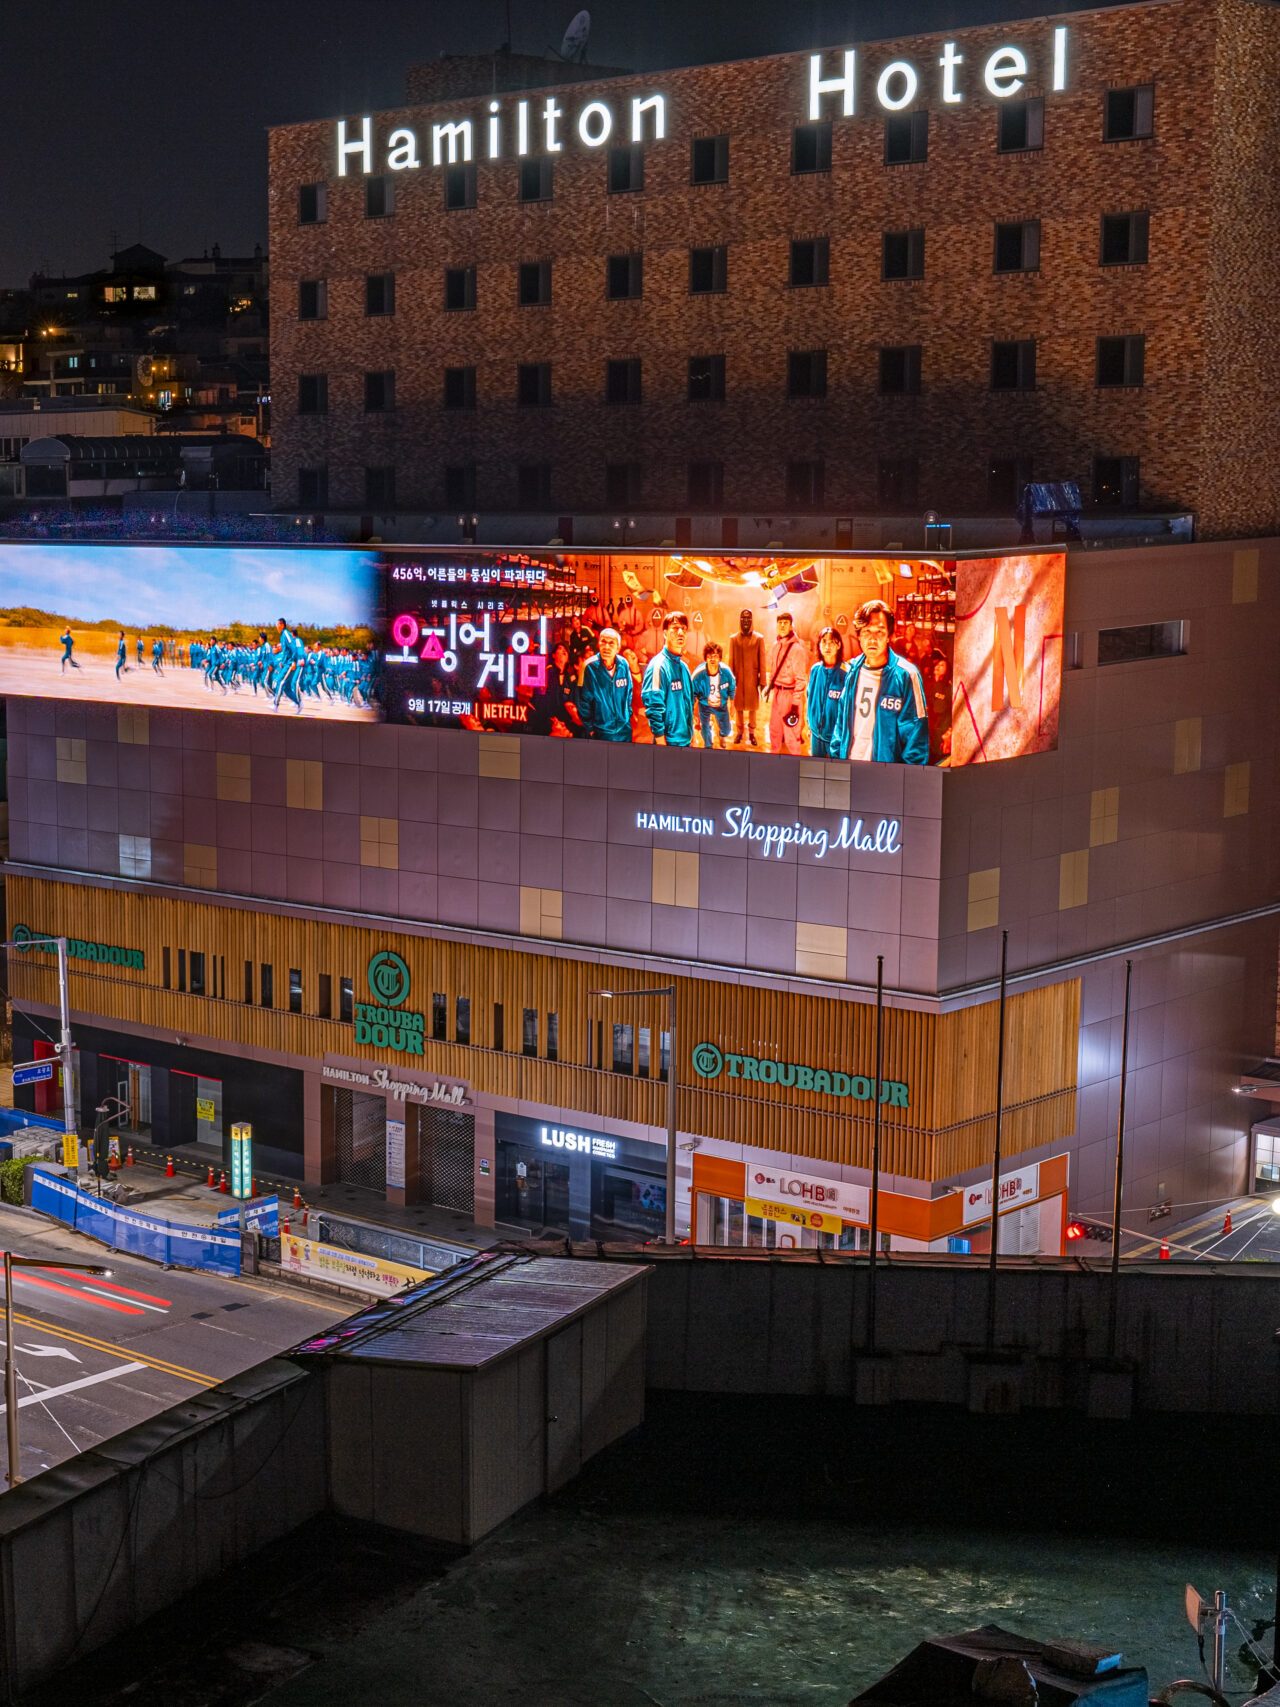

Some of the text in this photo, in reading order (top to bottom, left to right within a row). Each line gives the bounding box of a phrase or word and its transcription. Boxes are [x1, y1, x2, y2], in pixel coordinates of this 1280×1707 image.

[337, 27, 1067, 177] Hamilton Hotel
[470, 568, 501, 583] 동심이
[504, 569, 546, 584] 파괴된다
[477, 601, 505, 610] 시리즈
[385, 613, 490, 673] 오징어
[476, 615, 548, 698] 게임
[615, 678, 628, 688] 001
[670, 681, 682, 691] 218
[408, 698, 527, 722] 9월 17일 공개 NETFLIX
[858, 687, 873, 718] 5
[879, 697, 903, 711] 456
[637, 805, 902, 858] HAMILTON Shopping Mall
[354, 1003, 424, 1032] TROUBA
[354, 1020, 425, 1056] DOUR
[322, 1066, 466, 1107] HAMILTON Shopping Mall
[725, 1053, 910, 1108] TROUBADOUR
[541, 1127, 591, 1154] LUSH
